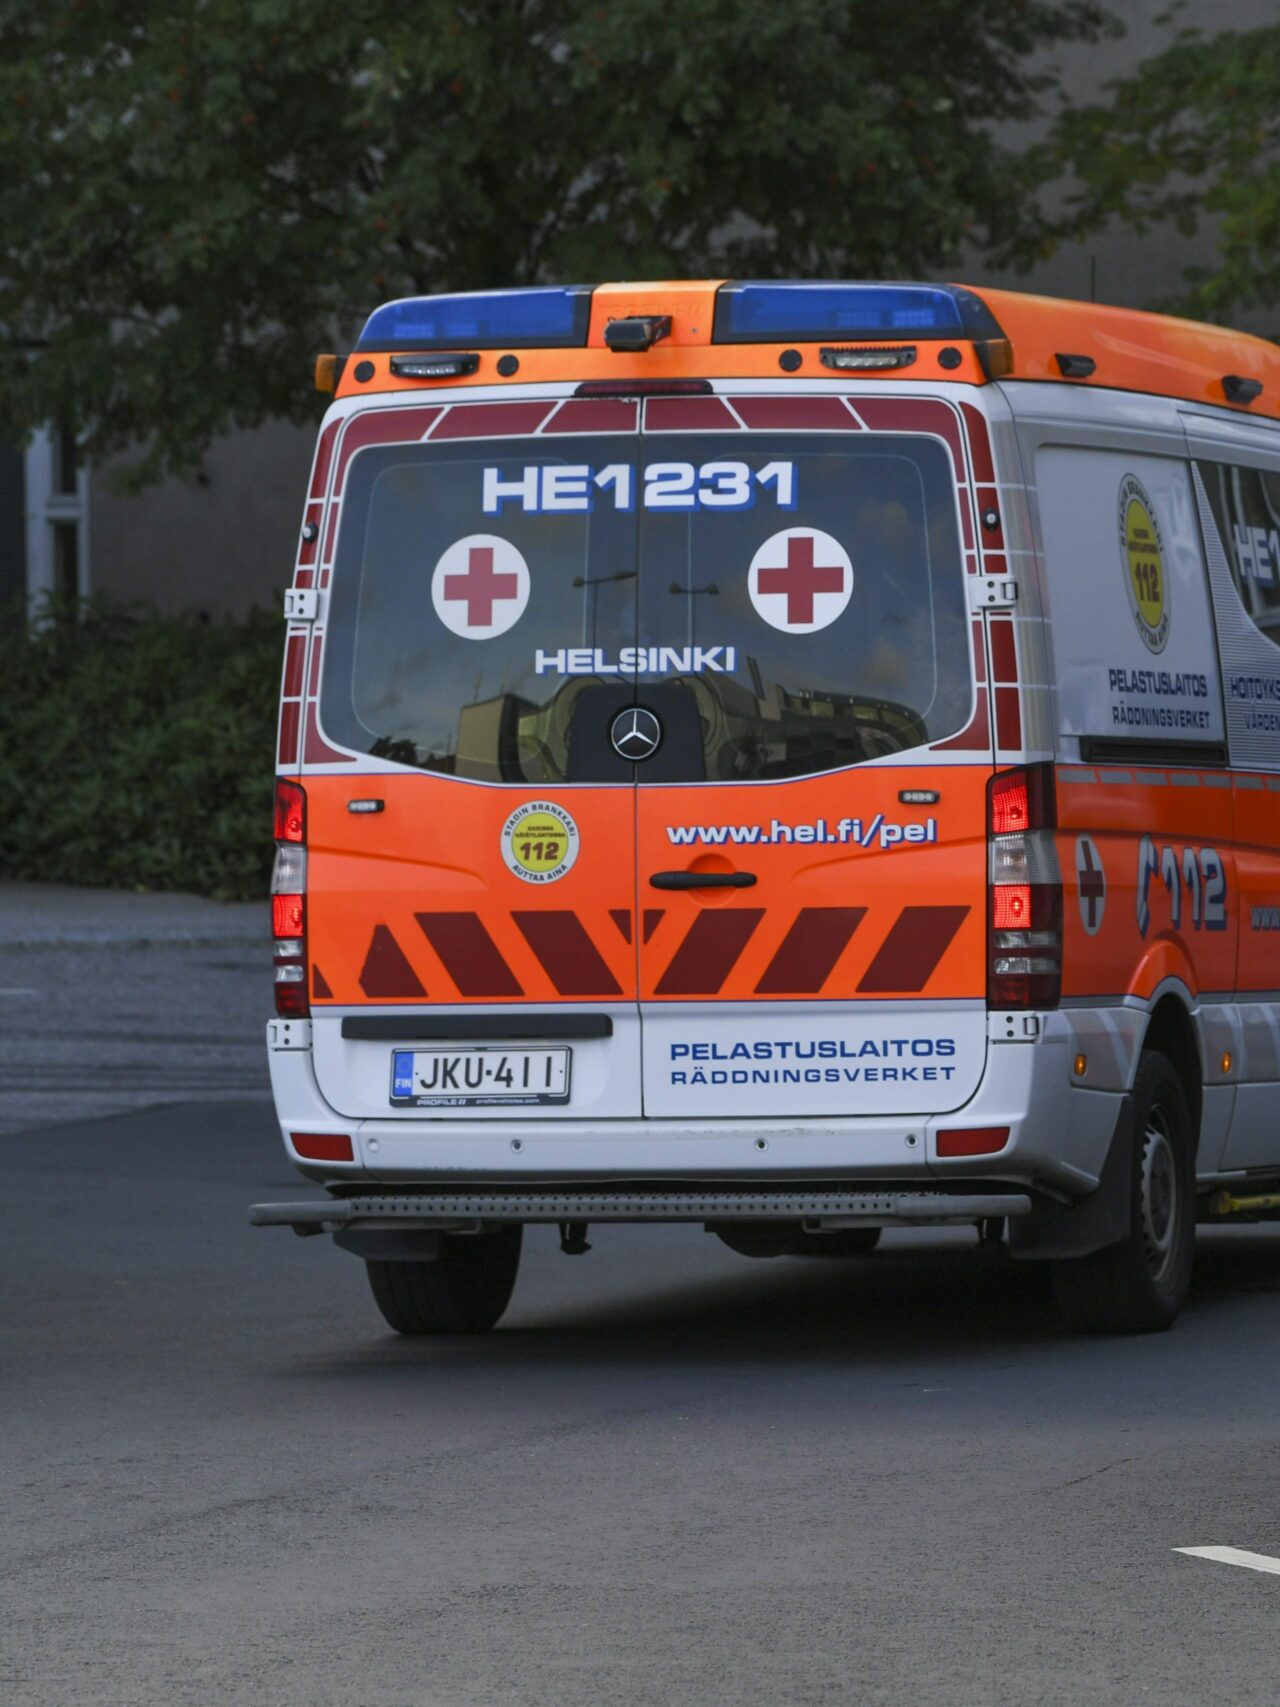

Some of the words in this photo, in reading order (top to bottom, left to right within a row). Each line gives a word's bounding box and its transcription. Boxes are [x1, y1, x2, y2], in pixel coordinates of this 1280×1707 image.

[482, 461, 797, 515] HE1231
[1135, 562, 1160, 602] 112
[535, 647, 739, 675] HELSINKI
[1109, 669, 1208, 697] PELASTUSLAITOS
[1112, 701, 1210, 729] RÄDDNINGSVERKET
[504, 807, 529, 837] STADIN
[532, 803, 576, 837] BRANKKARI
[667, 814, 937, 848] www.hel.fi/pel
[520, 842, 559, 860] 112
[512, 864, 545, 881] AUTTAA
[547, 864, 567, 880] AINA
[1161, 846, 1227, 931] 112
[670, 1039, 956, 1061] PELASTUSLAITOS
[395, 1078, 412, 1089] FIN
[420, 1056, 552, 1089] JKU-411
[671, 1066, 956, 1085] RÄDDNINGSVERKET
